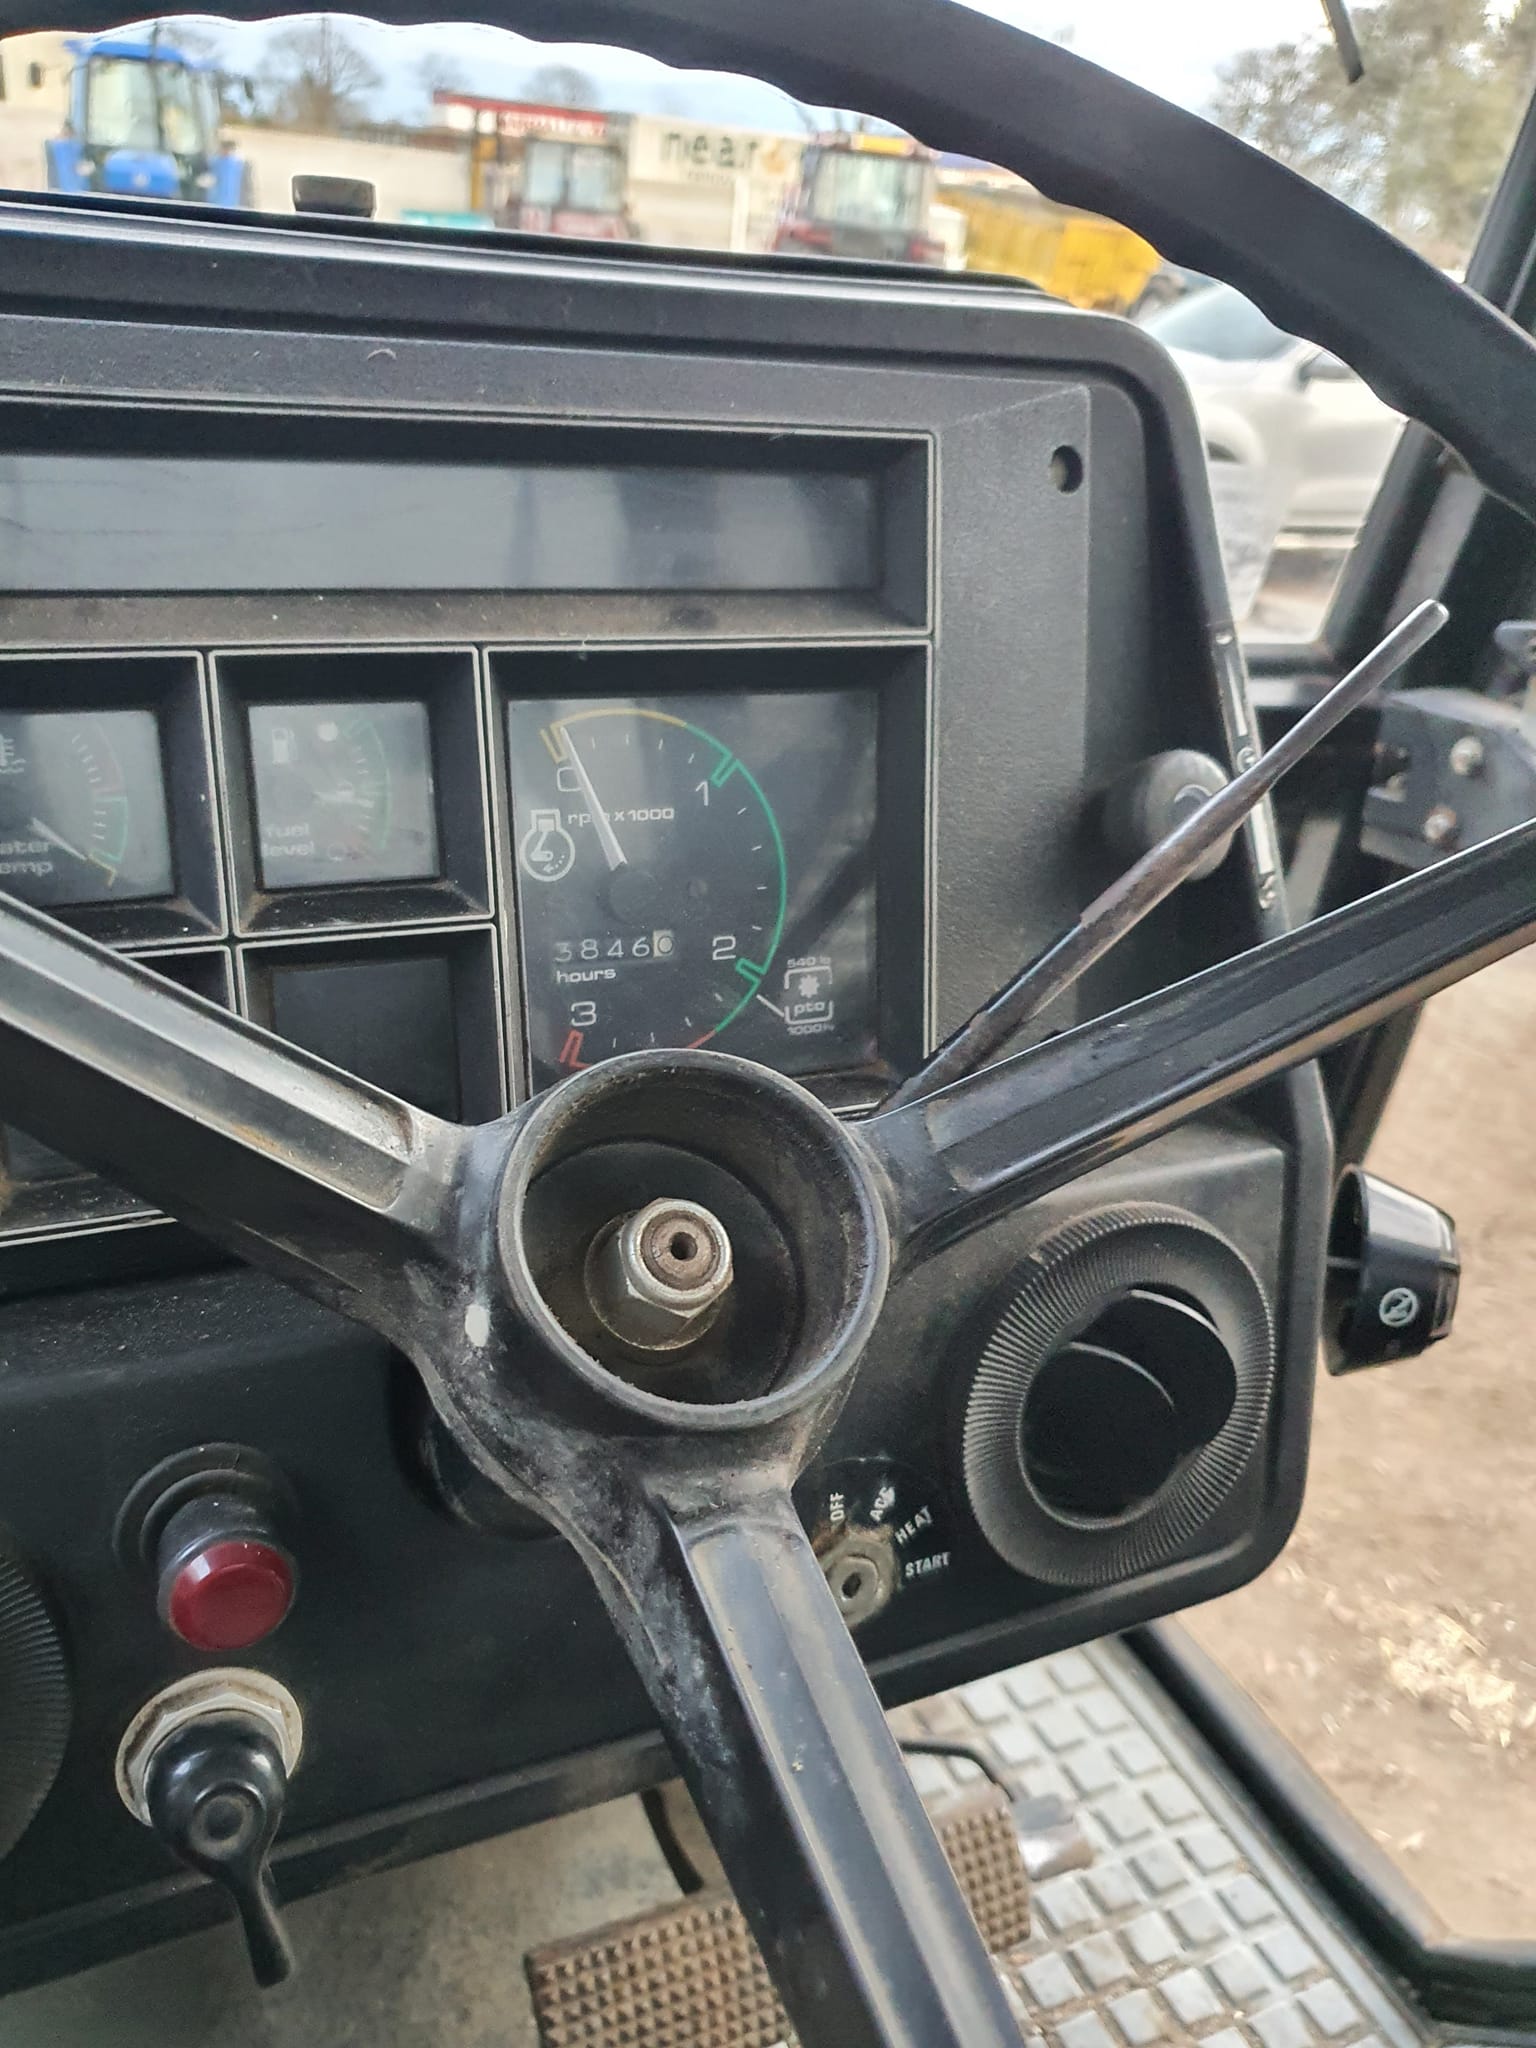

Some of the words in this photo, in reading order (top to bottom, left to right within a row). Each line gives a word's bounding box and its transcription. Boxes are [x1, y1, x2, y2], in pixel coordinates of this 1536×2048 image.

[695, 781, 709, 806] 1
[567, 811, 611, 828] rp
[712, 935, 737, 960] 2
[556, 967, 617, 984] hours
[571, 1001, 597, 1027] 3
[794, 1001, 826, 1017] pto
[829, 1491, 846, 1522] OFF
[894, 1504, 934, 1545] HEAT
[904, 1551, 951, 1579] START
